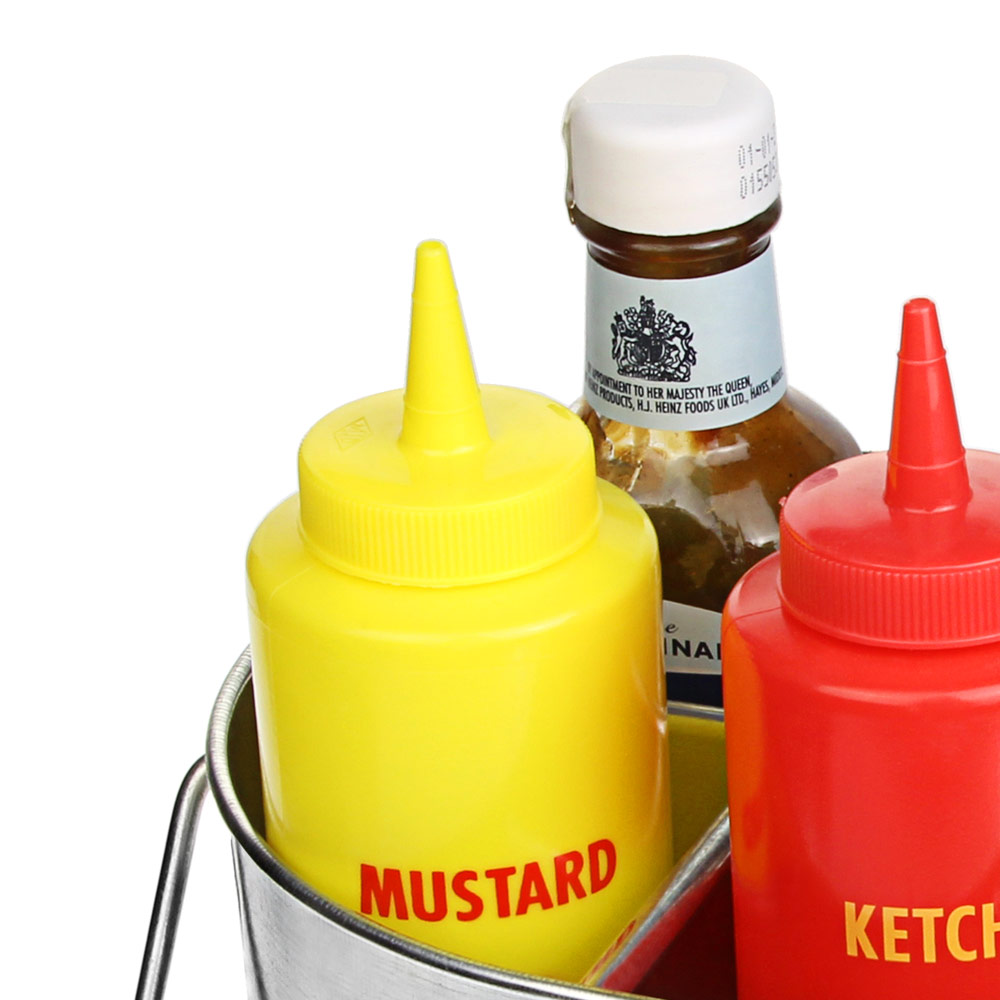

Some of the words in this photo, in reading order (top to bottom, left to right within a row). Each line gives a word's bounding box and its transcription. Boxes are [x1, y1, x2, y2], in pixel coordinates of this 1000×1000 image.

[600, 386, 636, 412] PRODUCTS,
[637, 400, 653, 413] H.J.
[656, 401, 682, 414] HEINZ
[685, 400, 715, 415] FOODS
[717, 397, 730, 411] UK
[633, 385, 645, 398] TO
[647, 387, 665, 400] HER
[666, 387, 704, 400] MAJESTY
[707, 383, 723, 398] THE
[725, 375, 753, 394] QUEEN,
[360, 838, 617, 923] MUSTARD
